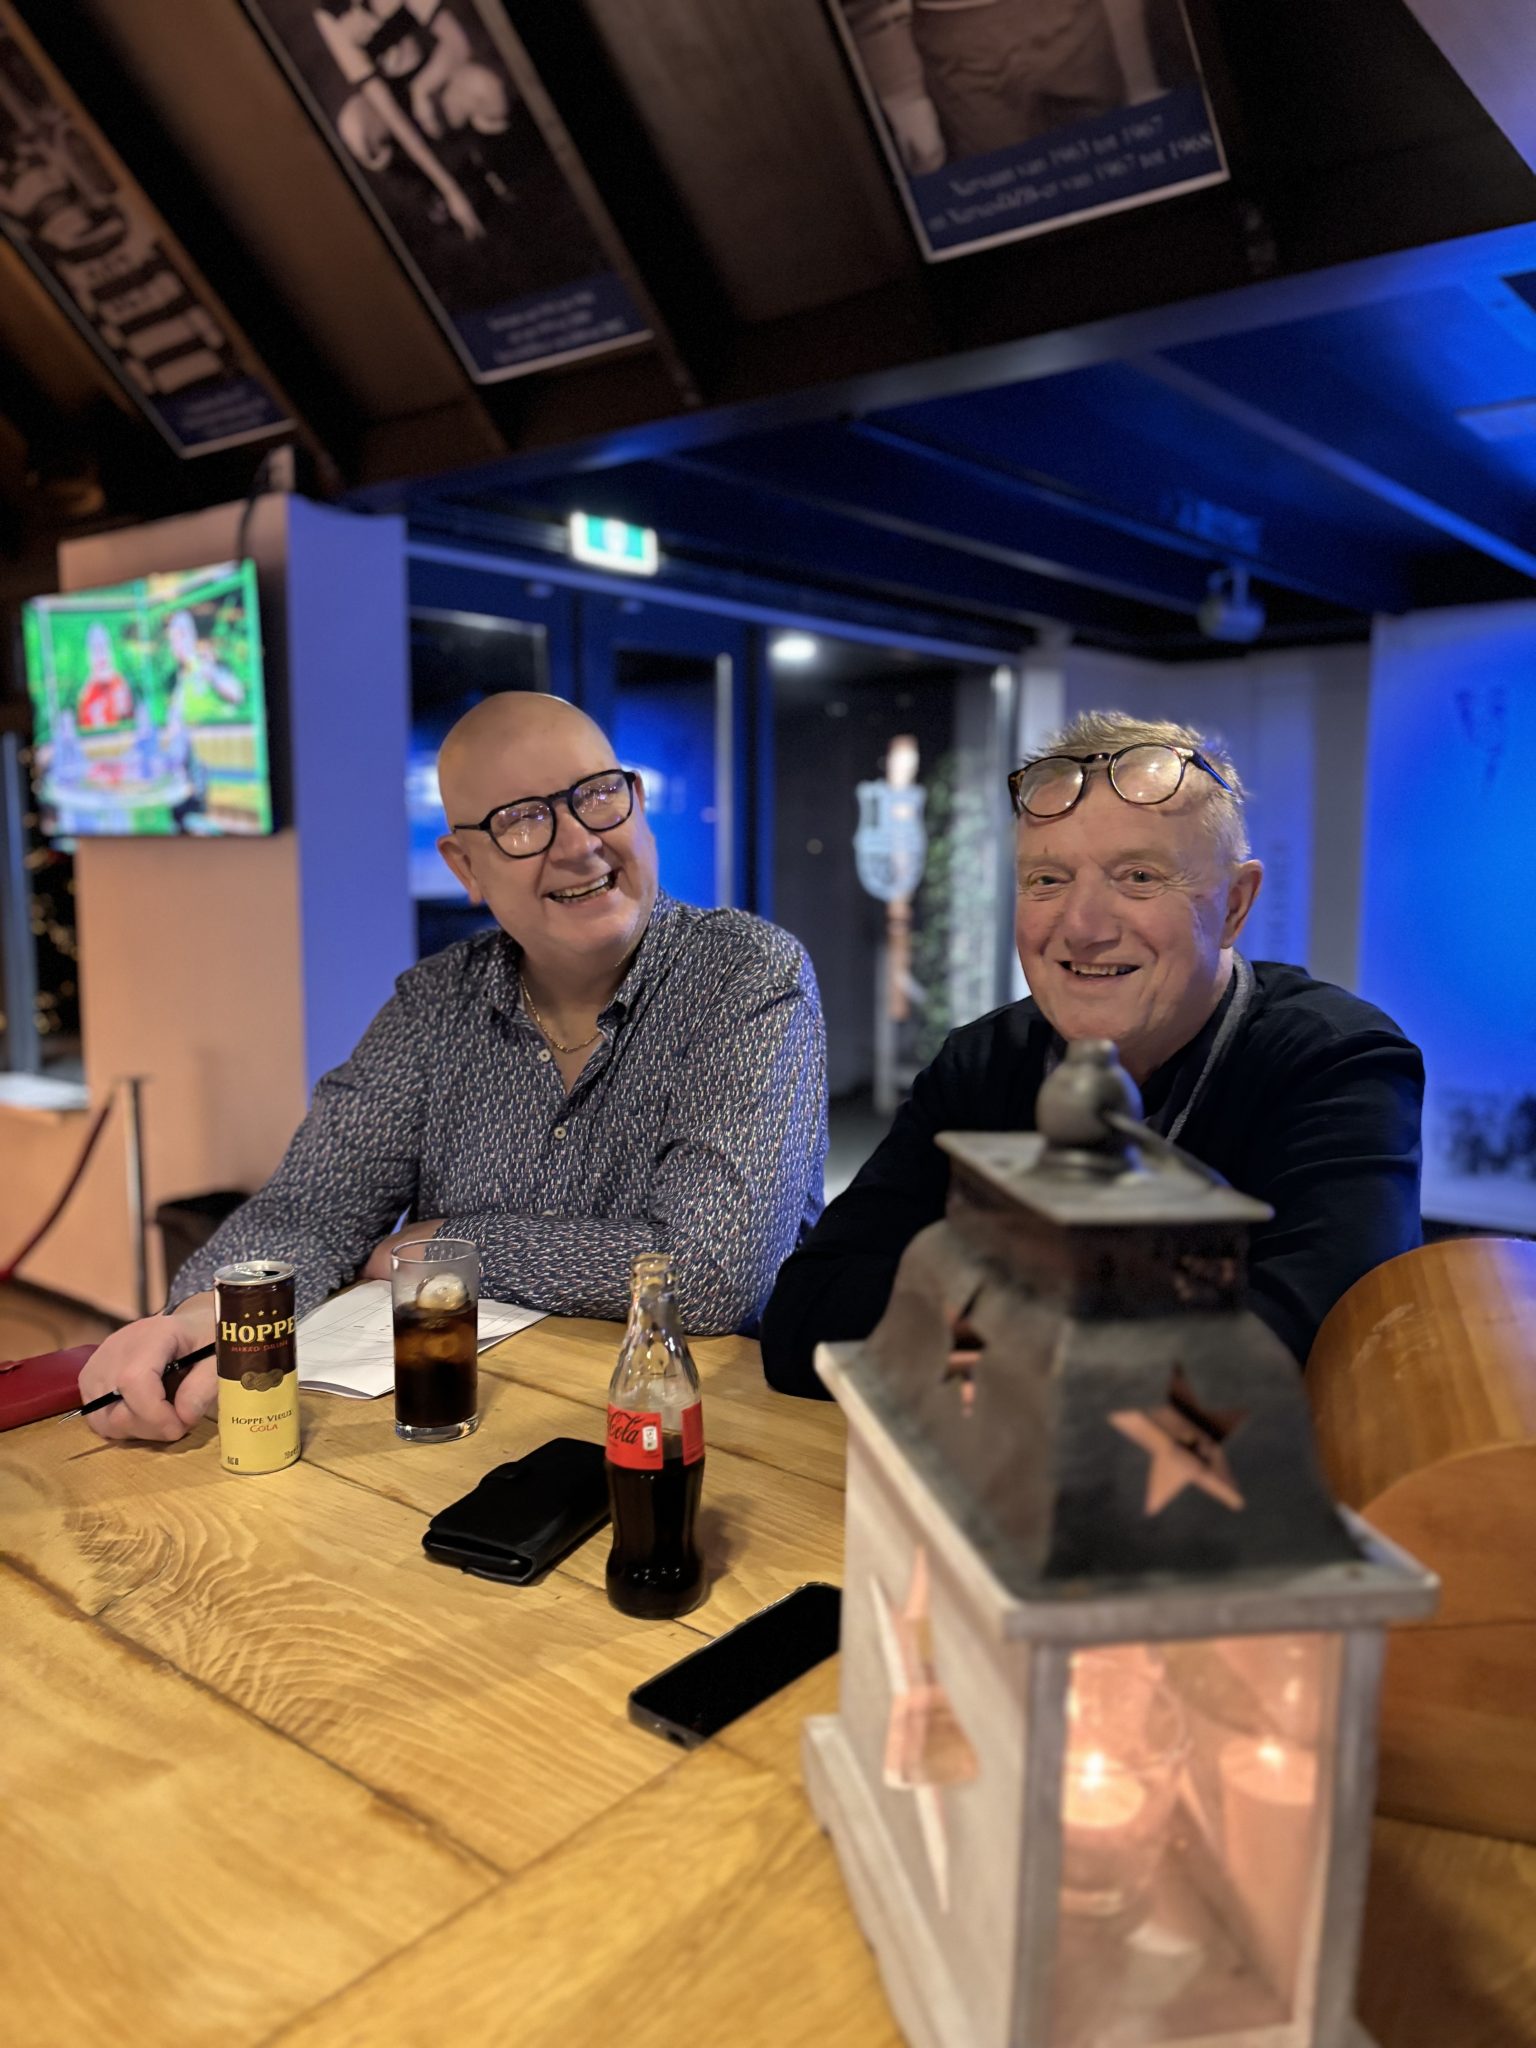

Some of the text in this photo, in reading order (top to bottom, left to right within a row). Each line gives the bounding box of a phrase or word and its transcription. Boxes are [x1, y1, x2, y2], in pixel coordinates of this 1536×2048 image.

[221, 1315, 297, 1344] HOPPE
[231, 1416, 264, 1426] HOPPE
[249, 1423, 279, 1433] COLA
